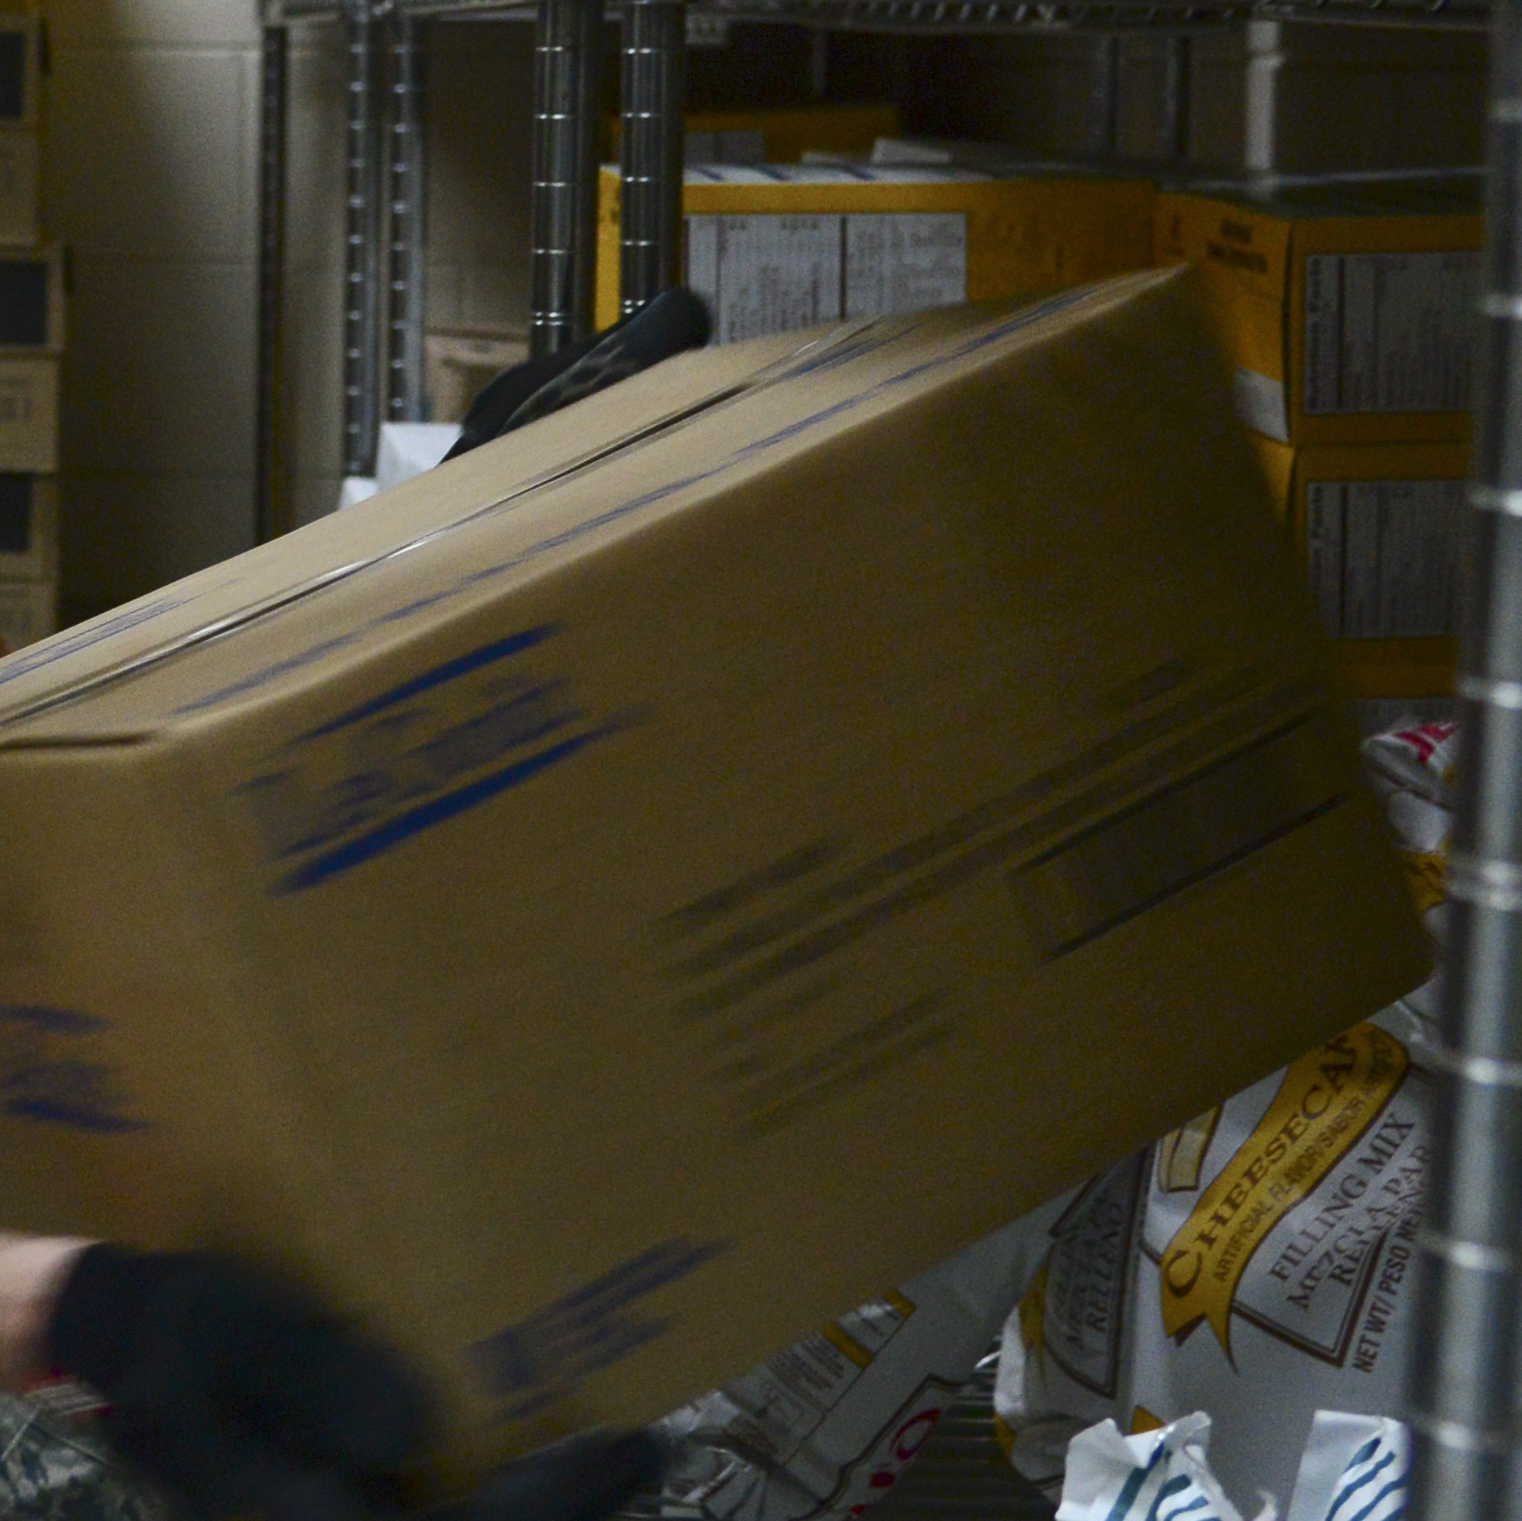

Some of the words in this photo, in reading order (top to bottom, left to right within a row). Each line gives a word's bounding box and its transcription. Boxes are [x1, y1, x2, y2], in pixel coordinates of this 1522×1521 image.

[1272, 1175, 1367, 1283] FILLING
[1359, 1111, 1415, 1172] MIX
[1378, 1243, 1409, 1295] PESO
